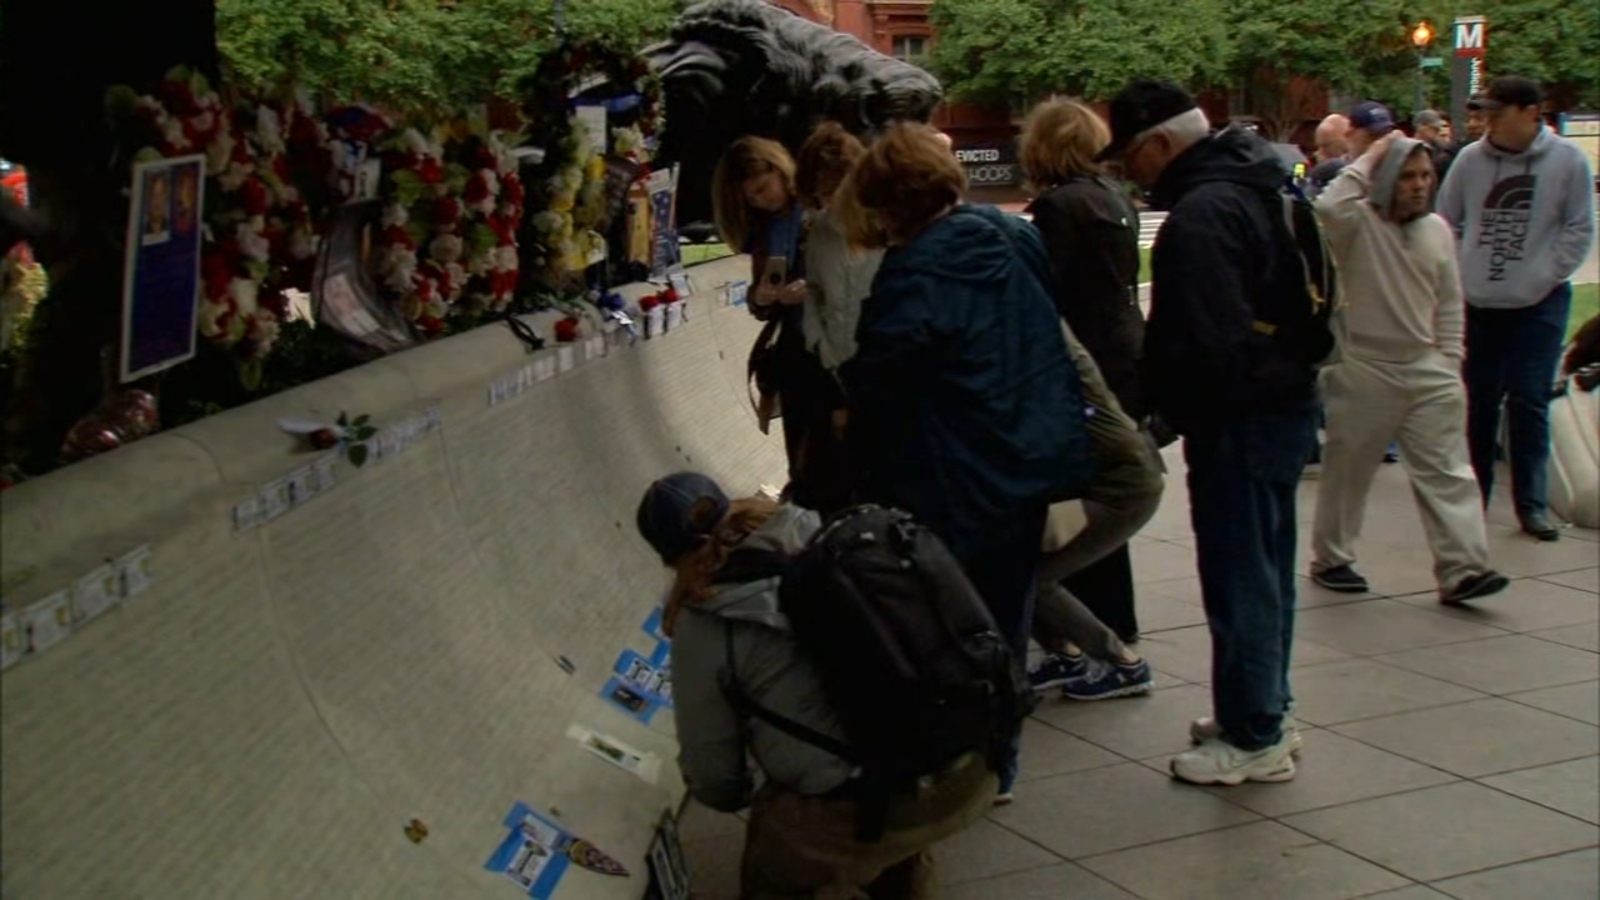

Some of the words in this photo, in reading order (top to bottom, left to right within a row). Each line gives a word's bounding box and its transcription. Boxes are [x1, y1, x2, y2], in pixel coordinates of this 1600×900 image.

[1455, 23, 1484, 49] M
[955, 149, 999, 162] EVICTED
[1479, 210, 1497, 246] THE
[1488, 210, 1513, 281] NORTH
[1506, 210, 1530, 260] FACE
